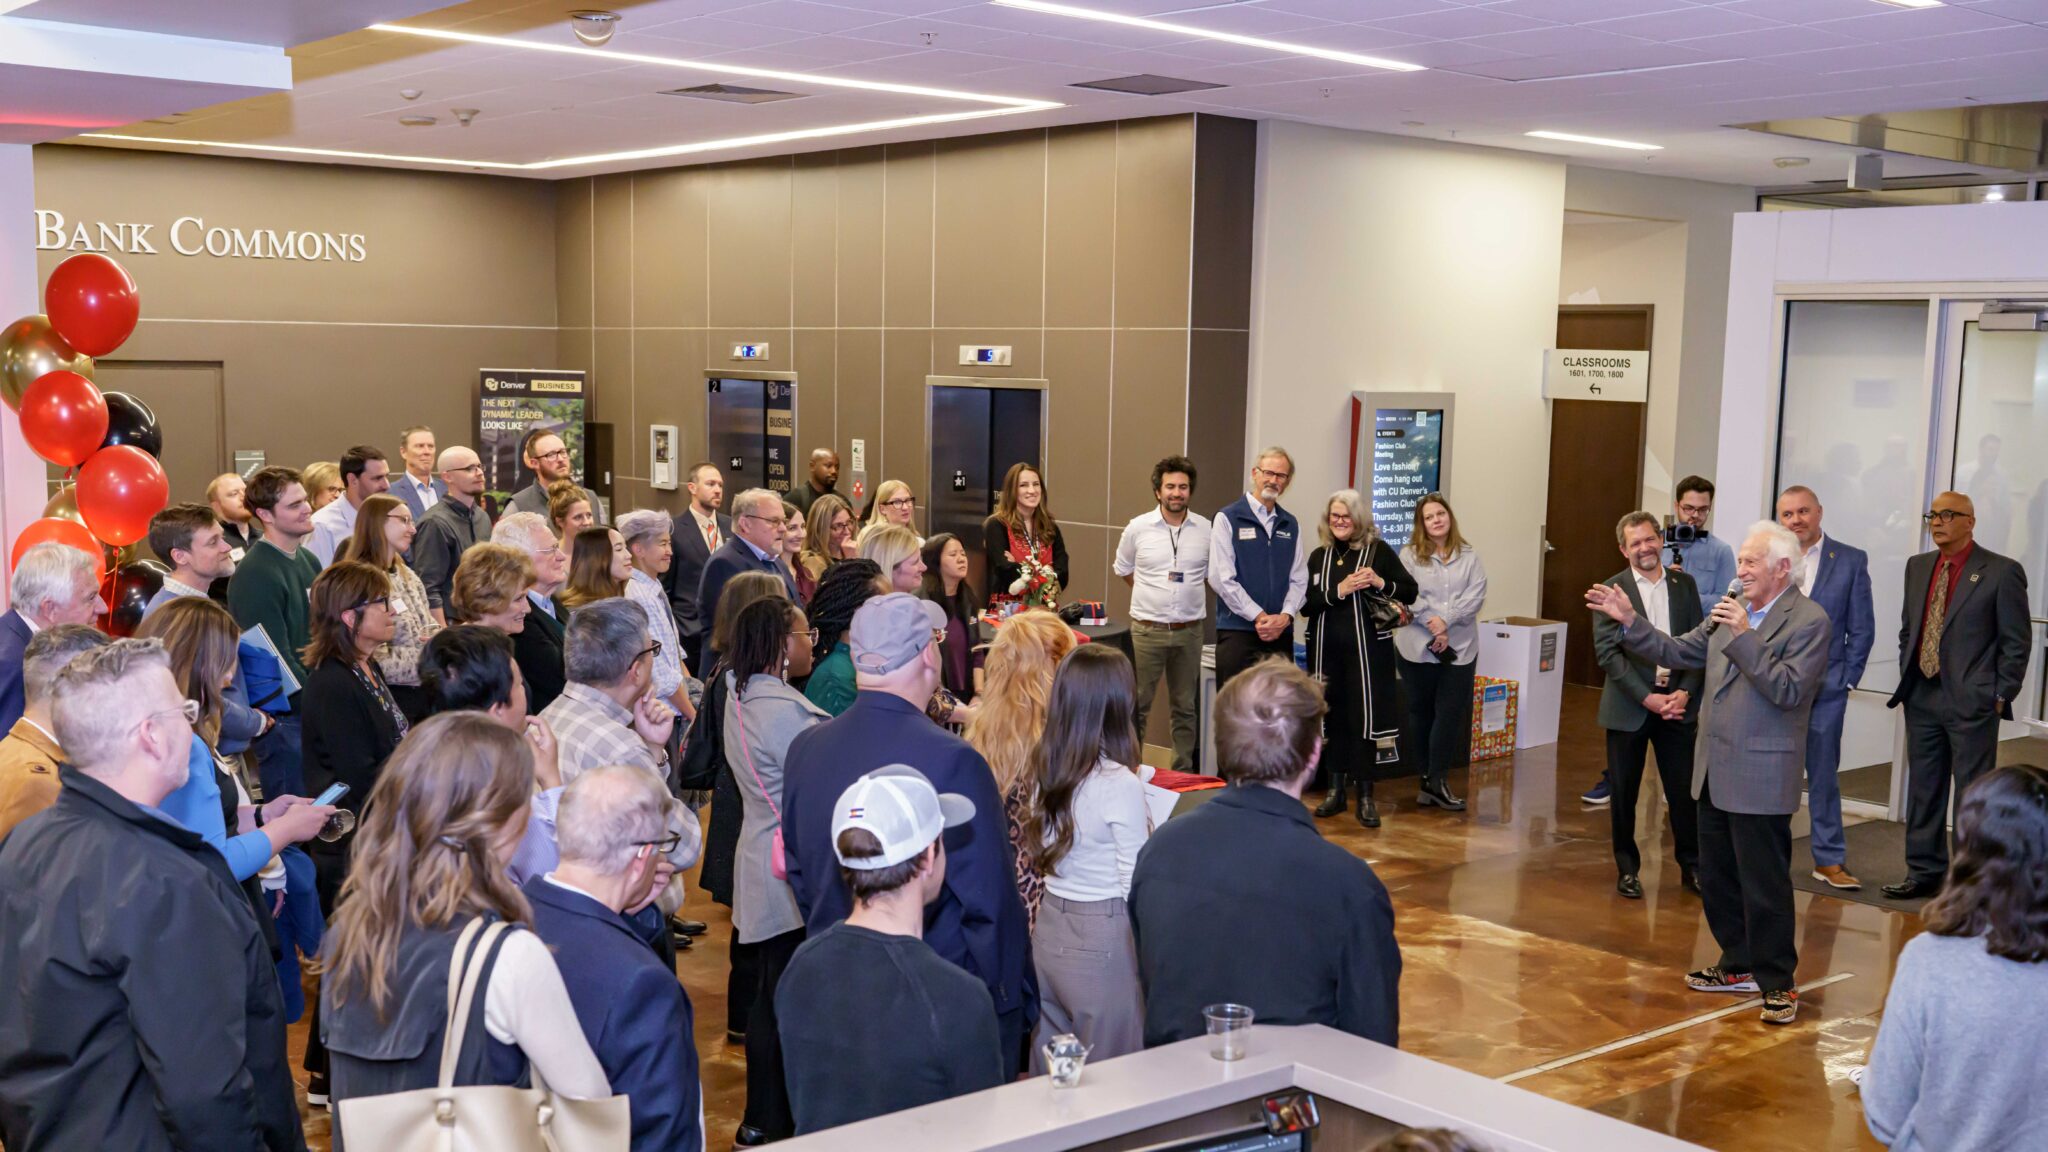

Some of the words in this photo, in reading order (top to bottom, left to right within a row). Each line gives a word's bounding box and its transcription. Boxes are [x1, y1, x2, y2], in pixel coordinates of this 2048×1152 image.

[170, 216, 367, 263] COMMONS
[1563, 357, 1631, 369] CLASSROOMS
[1569, 370, 1586, 378] 1601,
[1588, 370, 1606, 378] 1700,
[1608, 371, 1624, 379] 1800
[500, 381, 526, 389] Denver
[537, 382, 576, 390] BUSINESS
[712, 380, 718, 393] 2
[482, 398, 496, 407] THE
[497, 399, 516, 407] NEXT
[481, 410, 515, 419] DYNAMIC
[515, 411, 544, 419] LEADER
[481, 421, 506, 430] LOOKS
[507, 421, 523, 430] LIKE
[768, 448, 778, 459] WE
[768, 463, 785, 475] OPEN
[1374, 462, 1390, 471] Love
[1373, 475, 1393, 483] Come
[1394, 475, 1410, 484] hang
[1411, 475, 1423, 483] out
[768, 479, 790, 491] DOORS
[1373, 487, 1387, 496] with
[1388, 487, 1398, 495] CU
[1399, 486, 1428, 495] Denver's
[1372, 499, 1399, 509] Fashion
[1373, 512, 1404, 522] Thursday,
